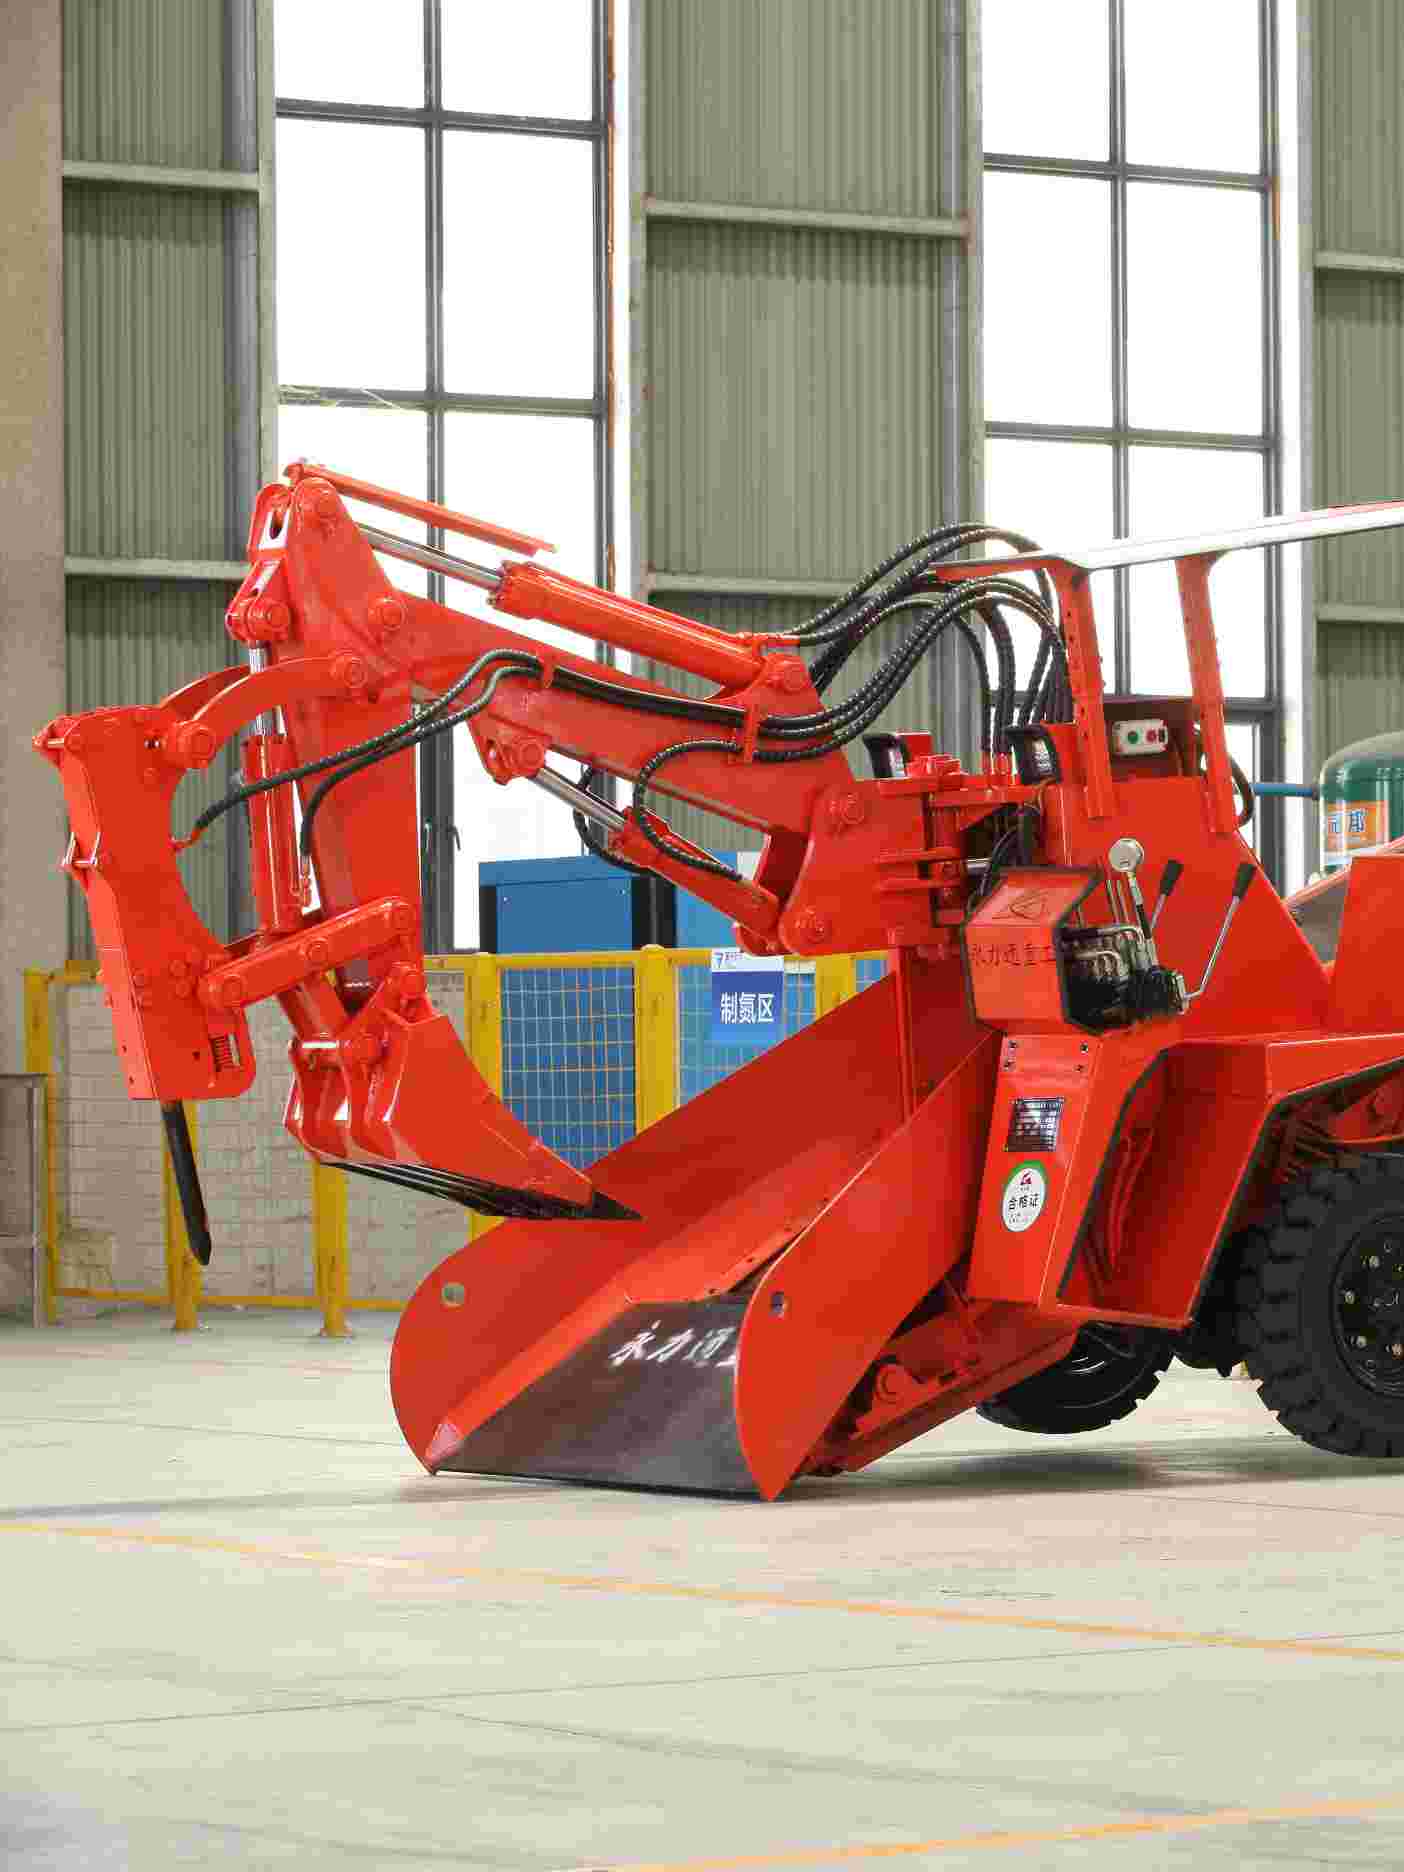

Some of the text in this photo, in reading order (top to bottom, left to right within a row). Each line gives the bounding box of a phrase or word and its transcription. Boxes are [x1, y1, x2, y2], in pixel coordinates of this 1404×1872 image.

[720, 992, 774, 1024] 制氮区
[1008, 1192, 1040, 1210] 合格证
